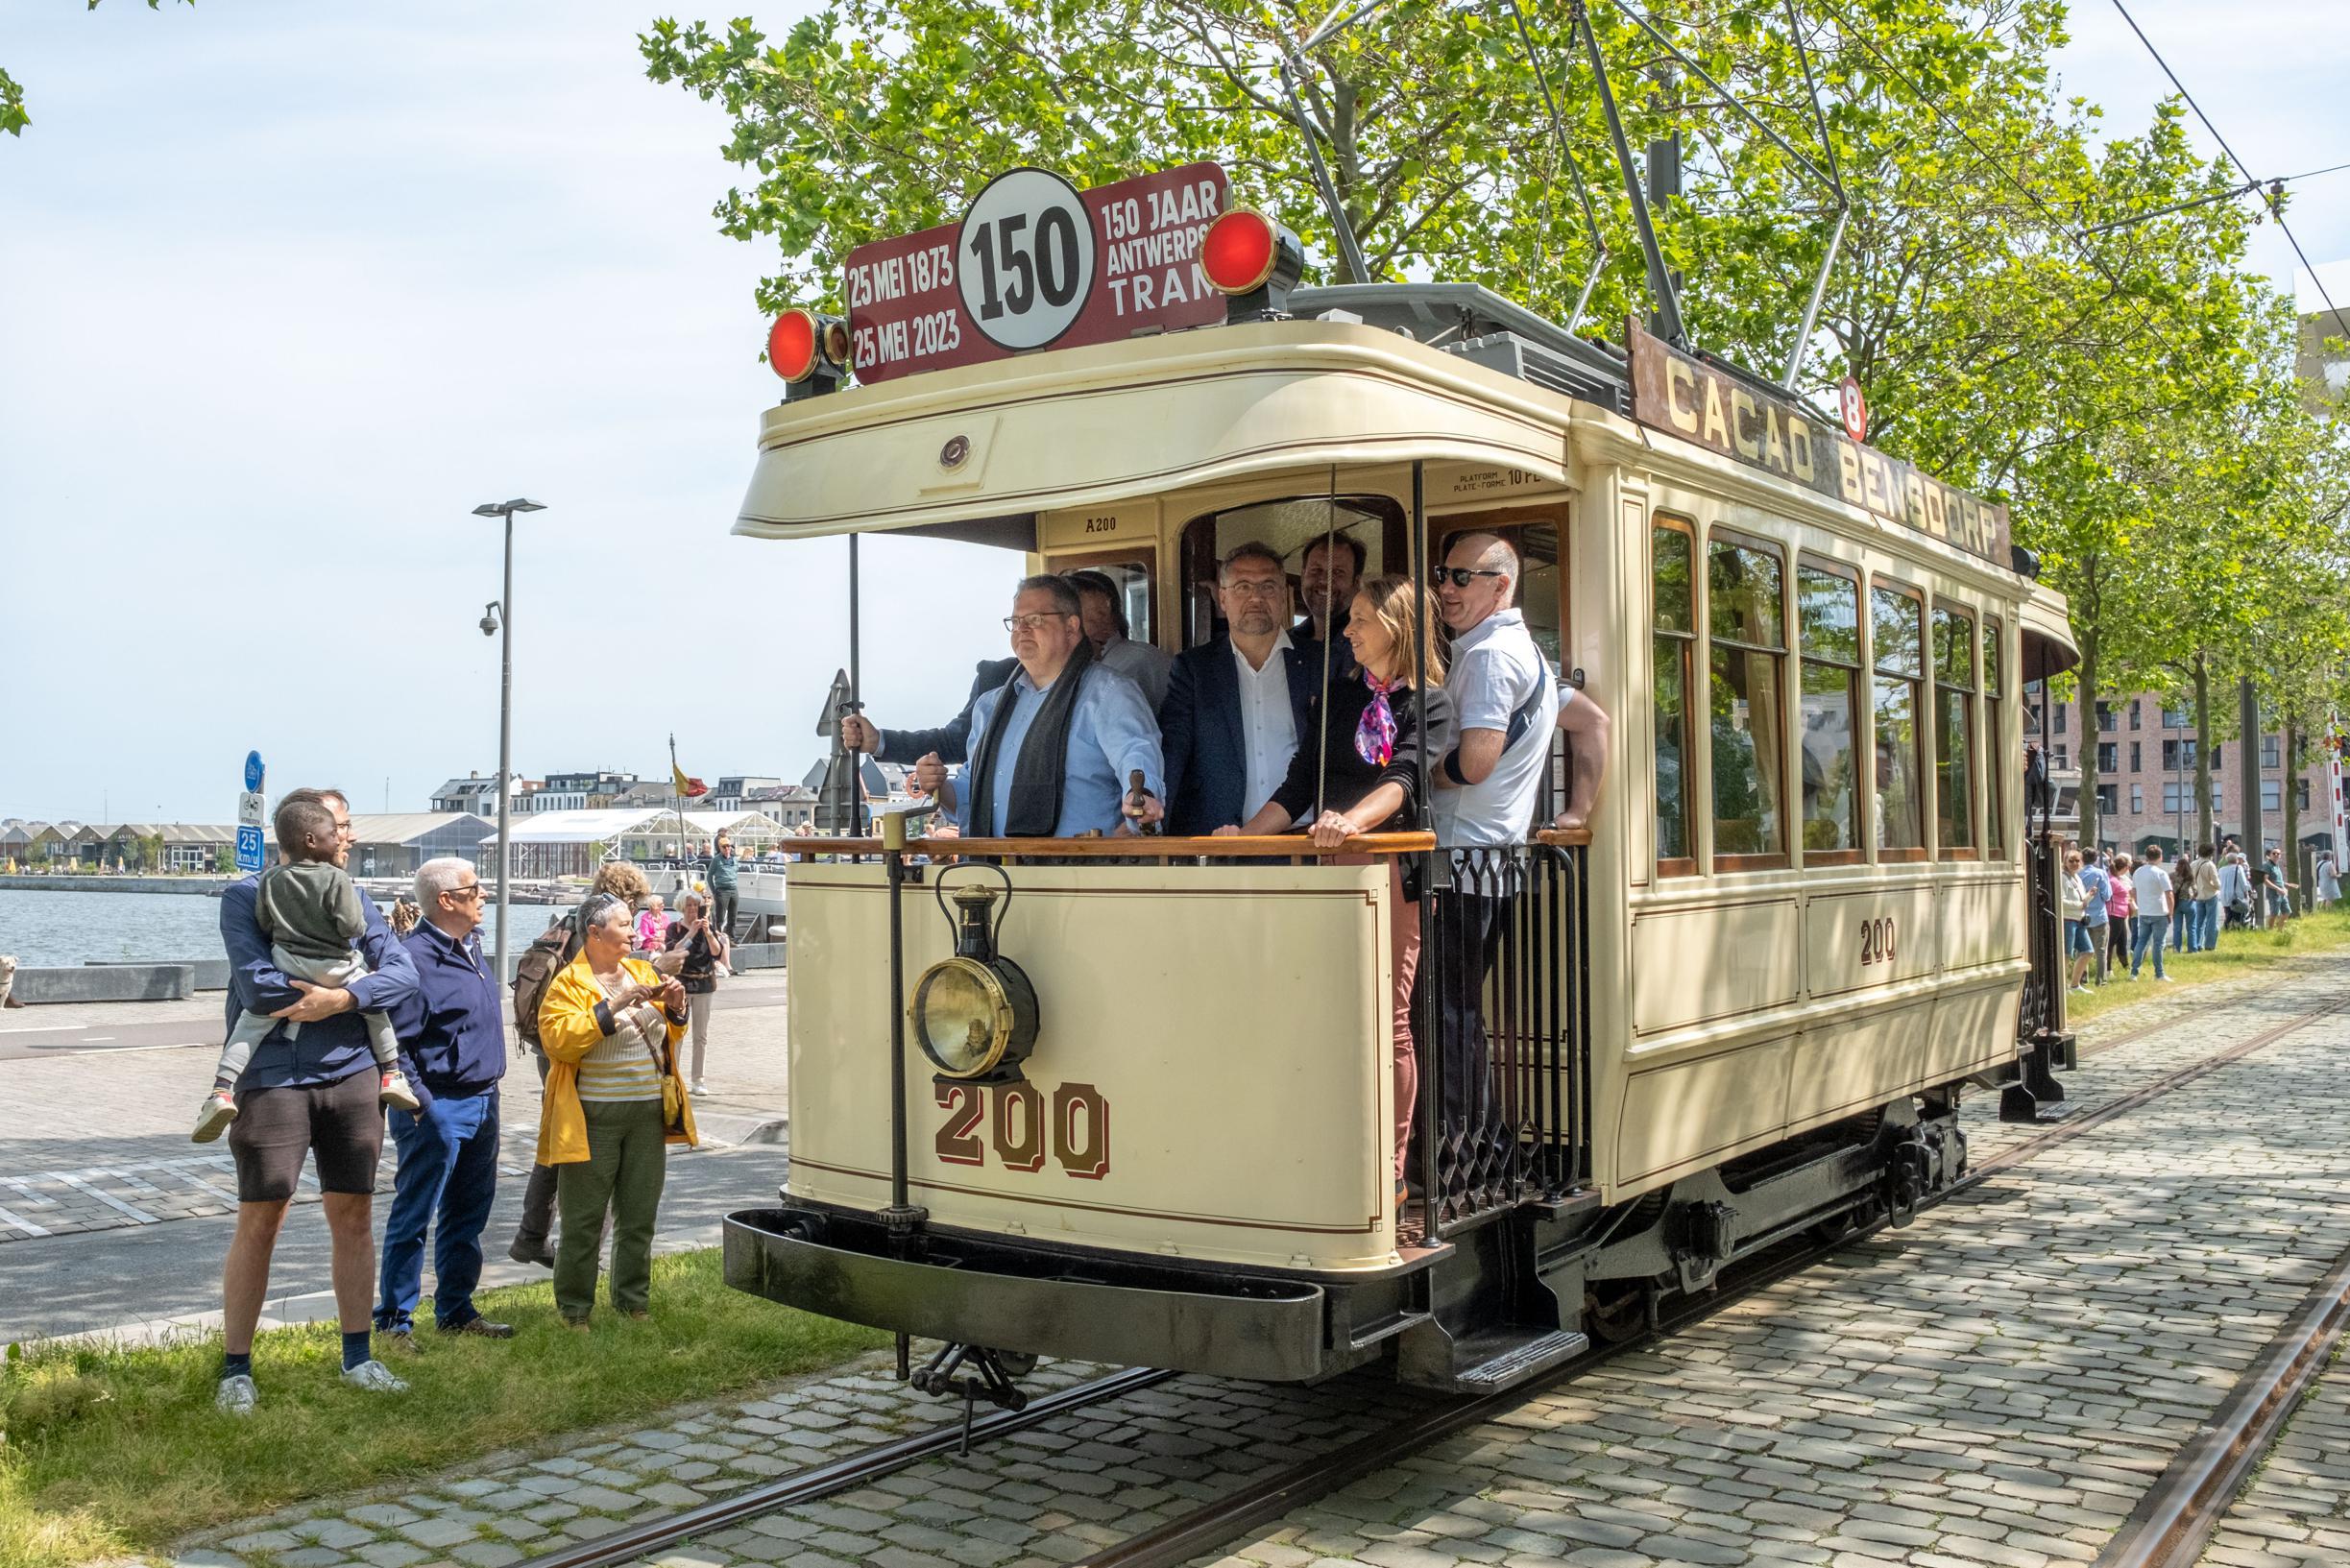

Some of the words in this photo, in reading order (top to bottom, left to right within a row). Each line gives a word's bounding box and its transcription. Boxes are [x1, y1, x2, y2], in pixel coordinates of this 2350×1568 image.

[1102, 198, 1140, 240] 150
[1148, 180, 1219, 231] JAAR
[849, 265, 872, 308] 25
[873, 256, 906, 302] MEI
[908, 244, 954, 294] 1873
[970, 205, 1080, 321] 150
[853, 326, 876, 369] 25
[878, 320, 909, 364] MEI
[912, 308, 960, 357] 2023
[1665, 355, 1814, 482] CACAO
[1845, 385, 1861, 433] 8
[1460, 471, 1498, 483] PLATFORM
[1508, 469, 1522, 485] 10
[1838, 441, 1997, 555] BENSDORP
[1085, 517, 1116, 533] A200
[238, 851, 258, 864] km/u
[241, 832, 256, 851] 25
[1860, 917, 1896, 966] 200
[933, 1079, 1110, 1181] 200
